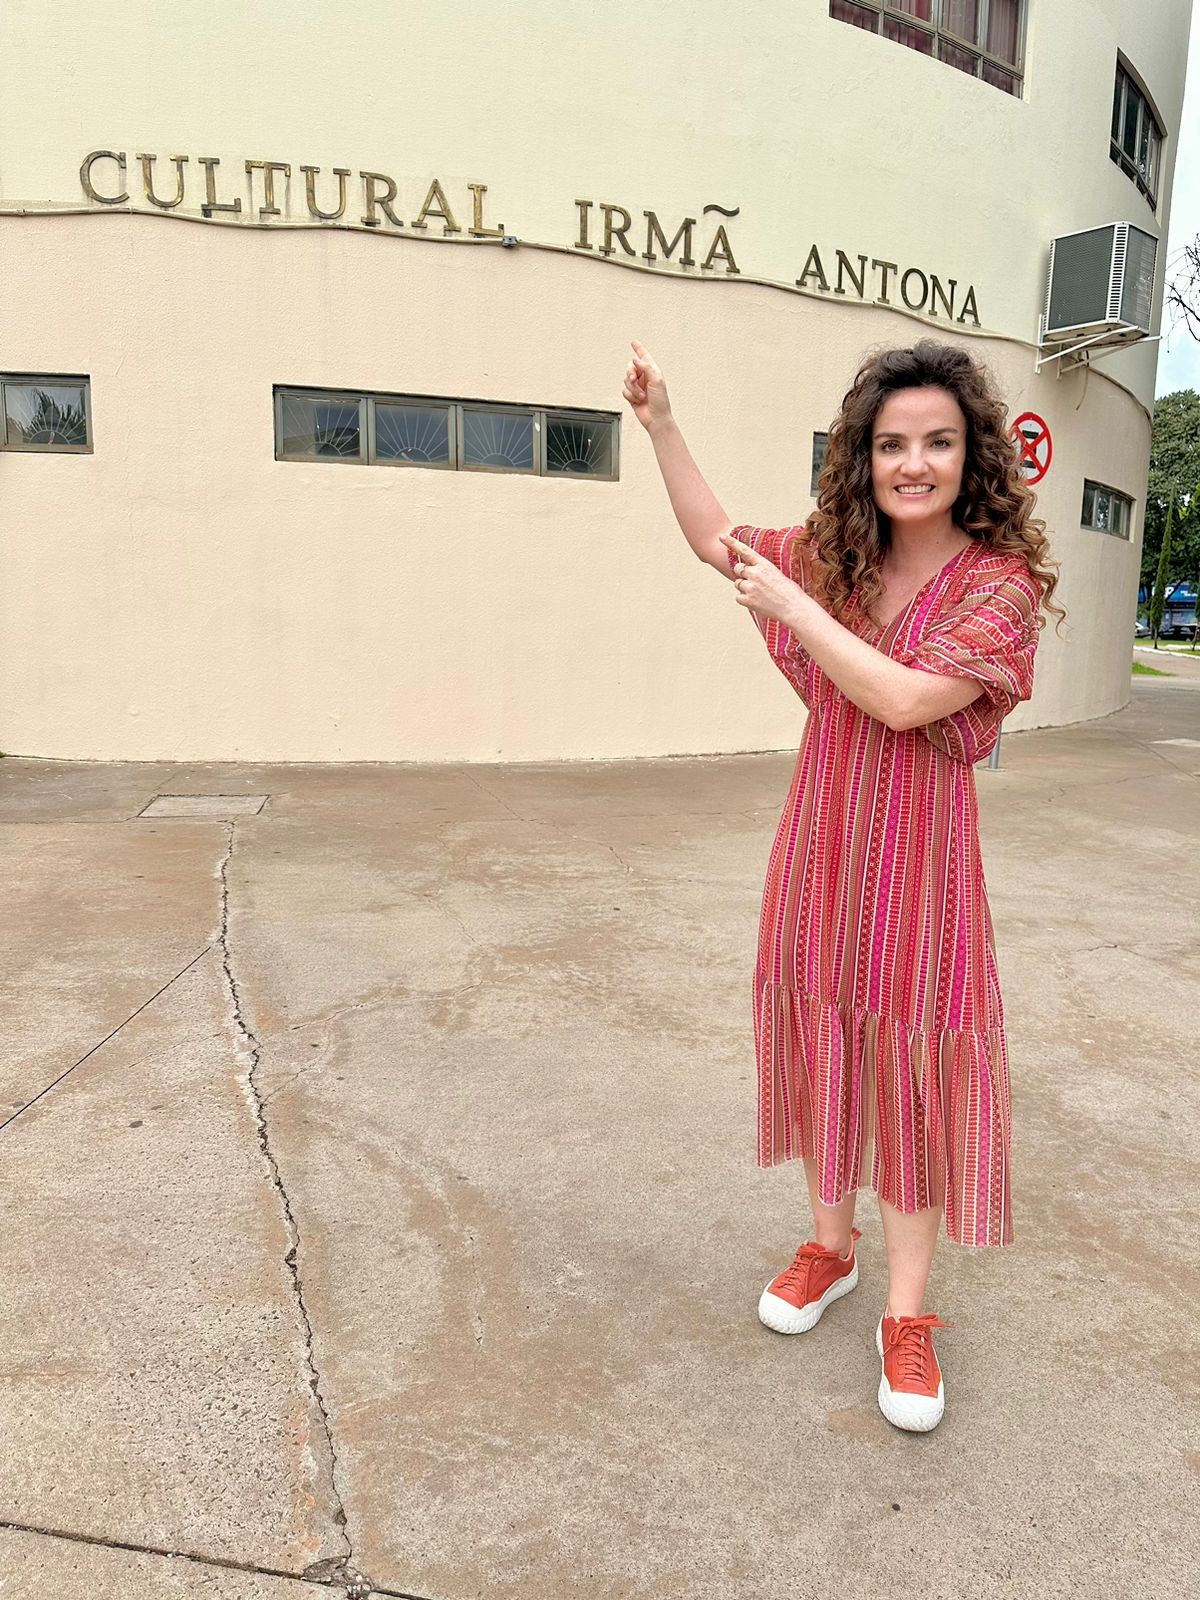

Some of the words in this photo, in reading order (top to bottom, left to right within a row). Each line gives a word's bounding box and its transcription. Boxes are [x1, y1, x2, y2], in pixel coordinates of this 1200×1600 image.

[80, 149, 505, 237] CULTURAL
[574, 199, 741, 274] IRMÃ
[795, 244, 982, 327] ANTONA
